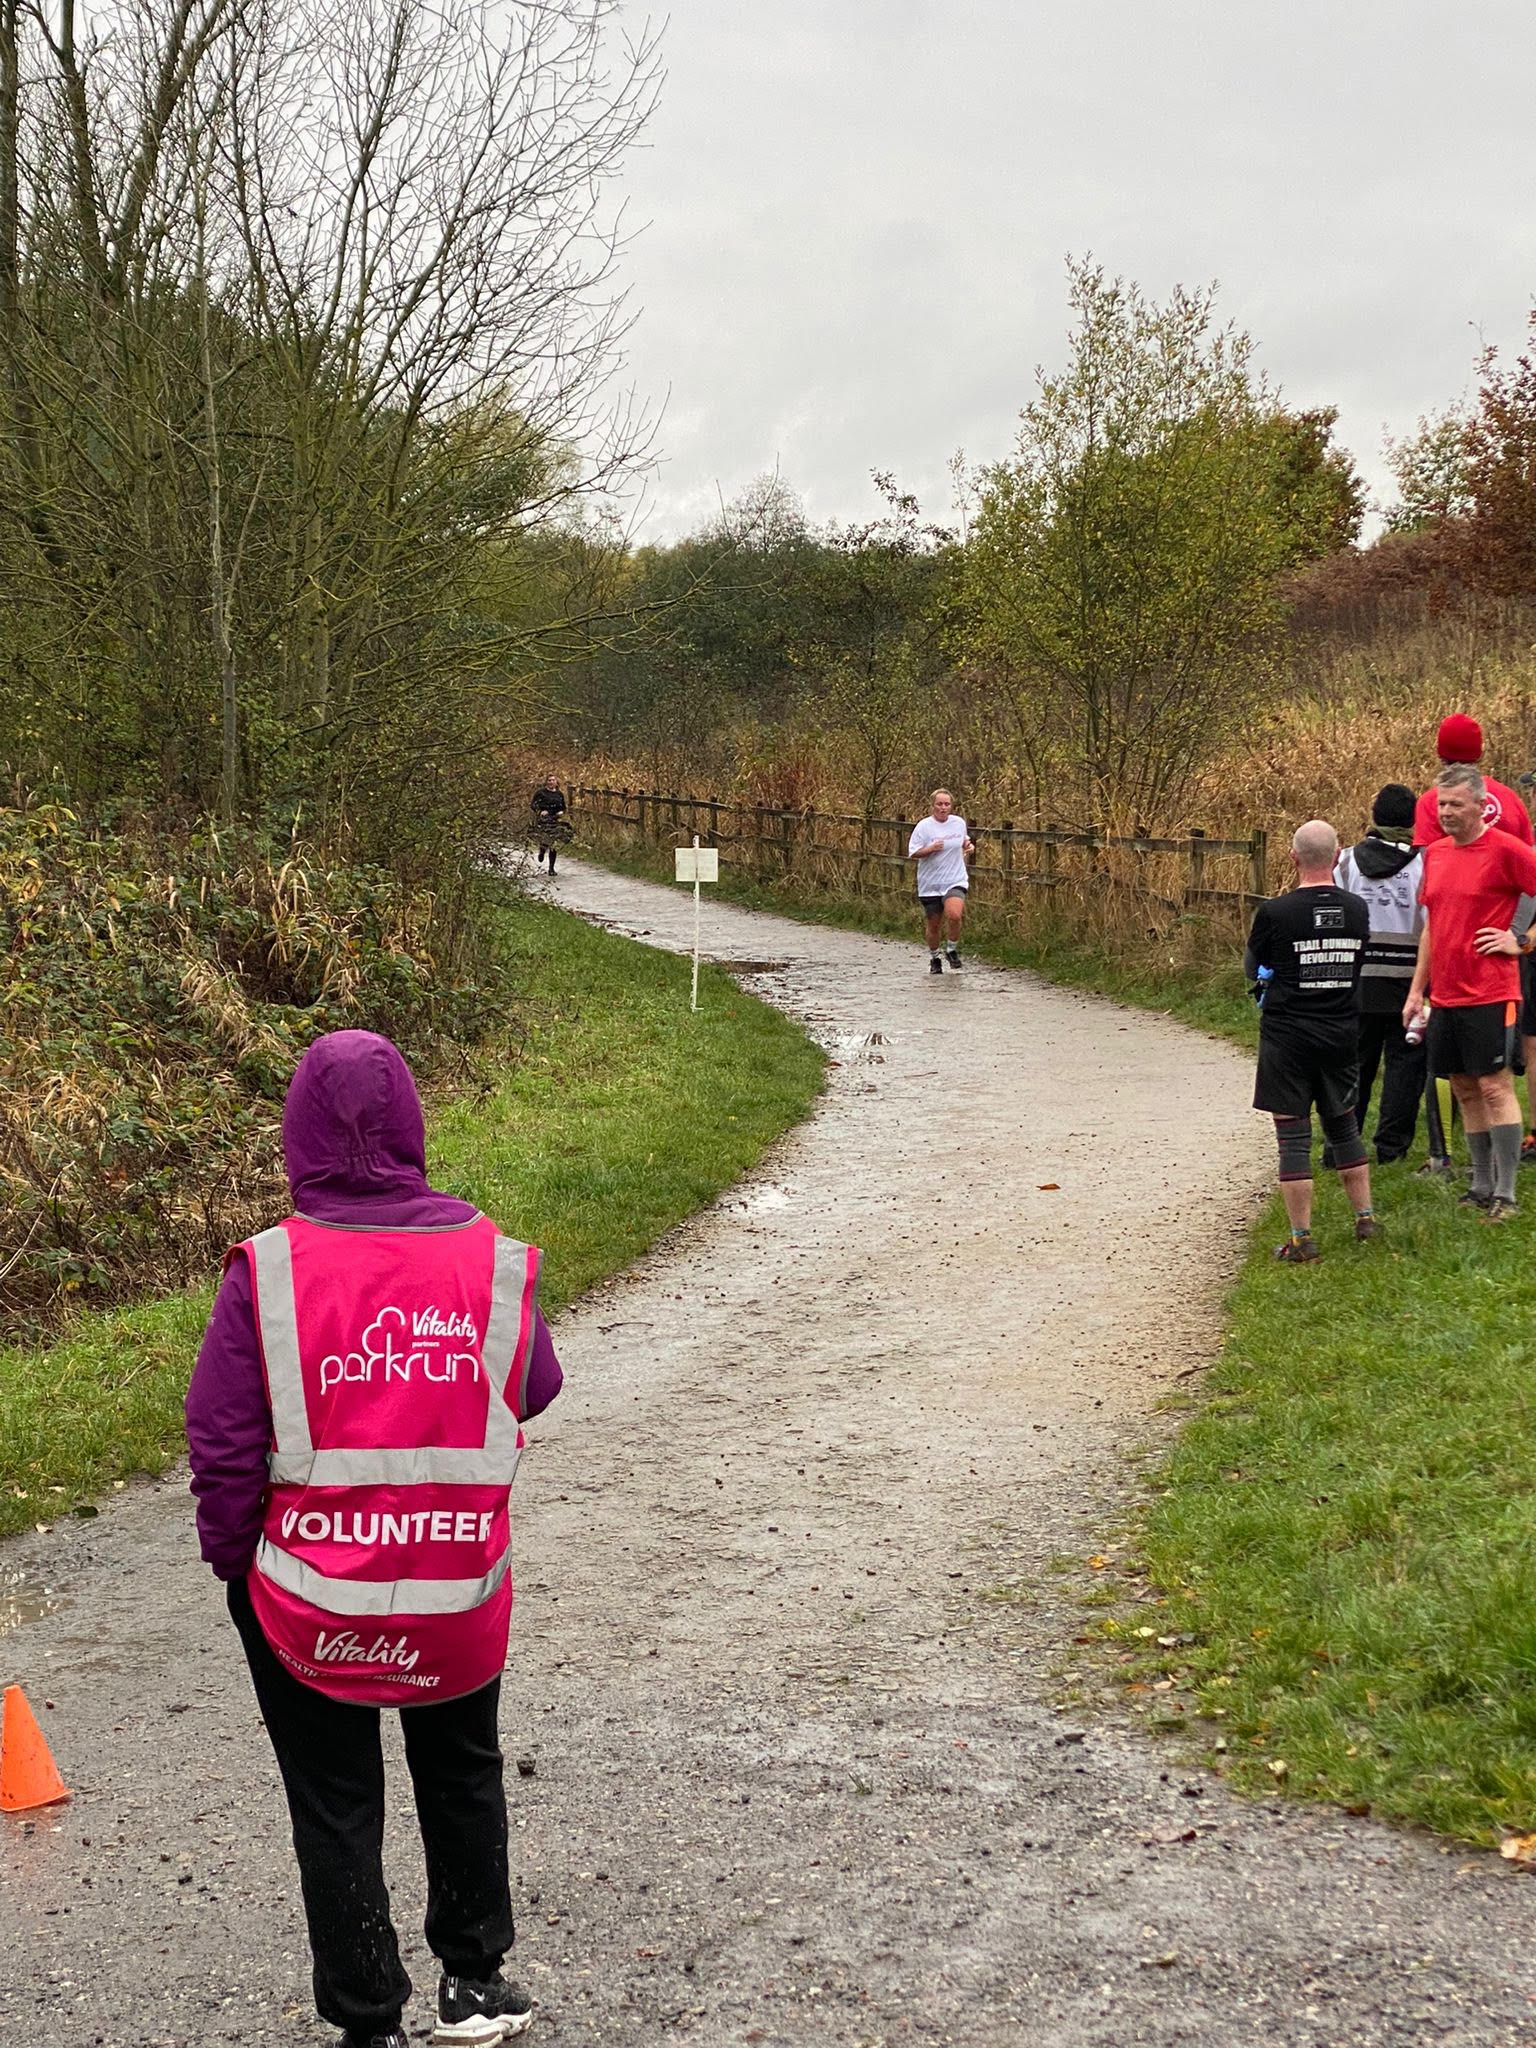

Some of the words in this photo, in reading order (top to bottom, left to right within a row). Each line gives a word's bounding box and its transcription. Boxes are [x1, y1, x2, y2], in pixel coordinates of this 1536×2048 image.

[1292, 939, 1321, 953] TRAIL
[1322, 938, 1362, 950] RUNNING
[1299, 952, 1355, 965] REVOLUTION
[412, 1305, 477, 1346] Vitality
[319, 1328, 479, 1396] parkrun
[278, 1649, 319, 1677] HEALTH
[314, 1630, 420, 1672] Vitality
